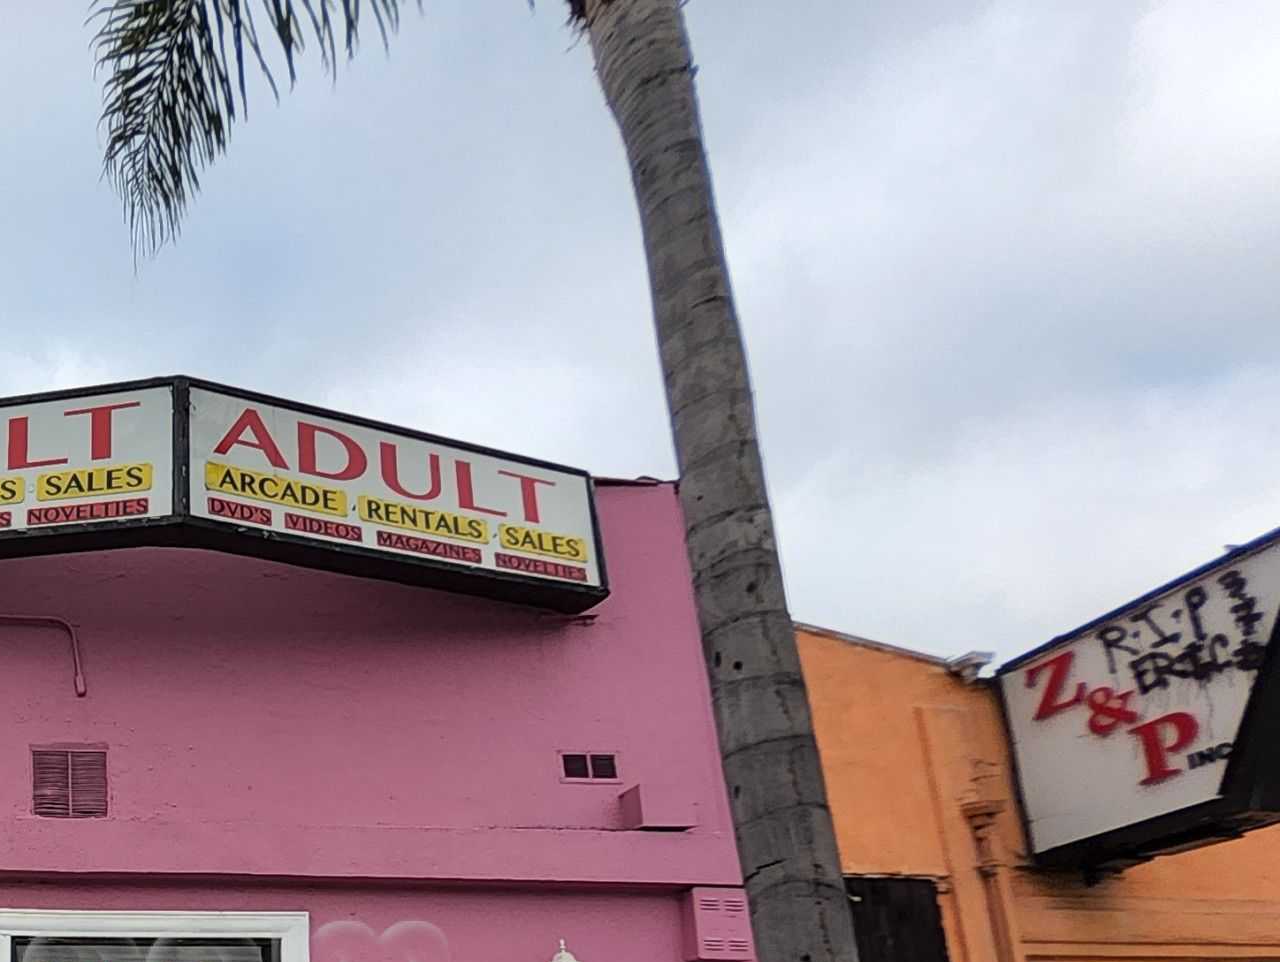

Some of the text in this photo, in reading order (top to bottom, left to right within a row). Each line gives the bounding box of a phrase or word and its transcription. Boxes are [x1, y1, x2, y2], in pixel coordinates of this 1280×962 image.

[44, 466, 144, 496] SALES
[213, 407, 556, 524] ADULT
[29, 499, 149, 524] NOVELTIES
[210, 499, 587, 581] DVD'S VIDEOS MAGAZINES NOVELTIES
[219, 469, 580, 558] ARCADE RENTALS SALES
